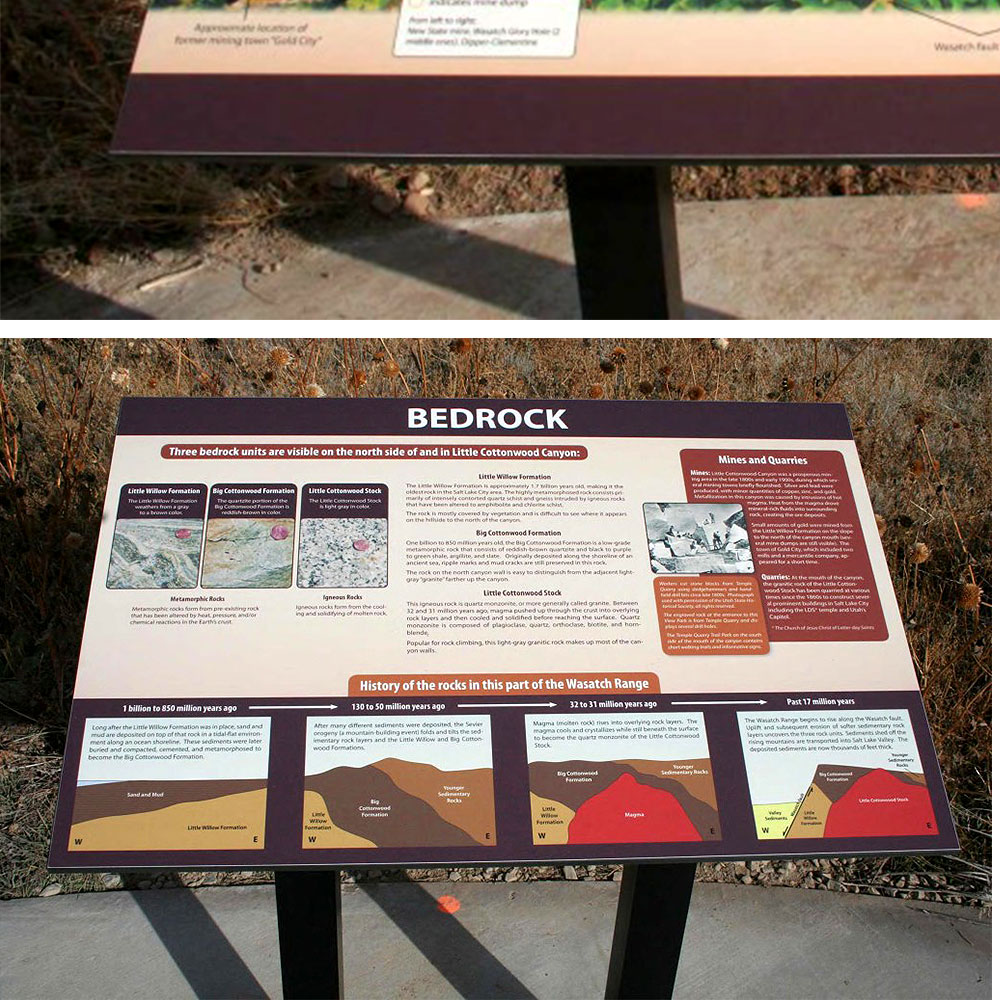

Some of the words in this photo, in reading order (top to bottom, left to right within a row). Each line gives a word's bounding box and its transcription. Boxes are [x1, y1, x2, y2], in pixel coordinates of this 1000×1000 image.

[408, 408, 568, 429] BEDROCK
[169, 447, 197, 456] Three
[199, 447, 239, 456] bedrock
[241, 447, 267, 456] units
[287, 447, 319, 456] visible
[336, 447, 353, 456] the
[355, 447, 383, 456] north
[385, 447, 405, 456] side
[407, 447, 418, 456] of
[419, 447, 438, 456] and
[440, 447, 450, 456] in
[452, 448, 479, 457] Little
[480, 448, 540, 457] Cottonwood
[541, 448, 580, 459] Canyon:
[719, 455, 747, 464] Mines
[749, 456, 767, 464] and
[768, 456, 808, 465] Quarries
[360, 680, 401, 694] History
[403, 679, 415, 691] of
[416, 679, 436, 691] the
[438, 679, 467, 691] rocks
[469, 679, 480, 690] in
[482, 679, 504, 690] this
[506, 680, 530, 692] part
[532, 678, 543, 690] of
[545, 678, 564, 690] the
[566, 678, 612, 689] Wasatch
[614, 678, 649, 691] Range
[128, 704, 152, 712] billion
[161, 704, 176, 712] 850
[176, 704, 202, 712] million
[203, 705, 222, 713] years
[223, 705, 237, 713] ago
[599, 700, 624, 708] million
[644, 701, 658, 709] ago
